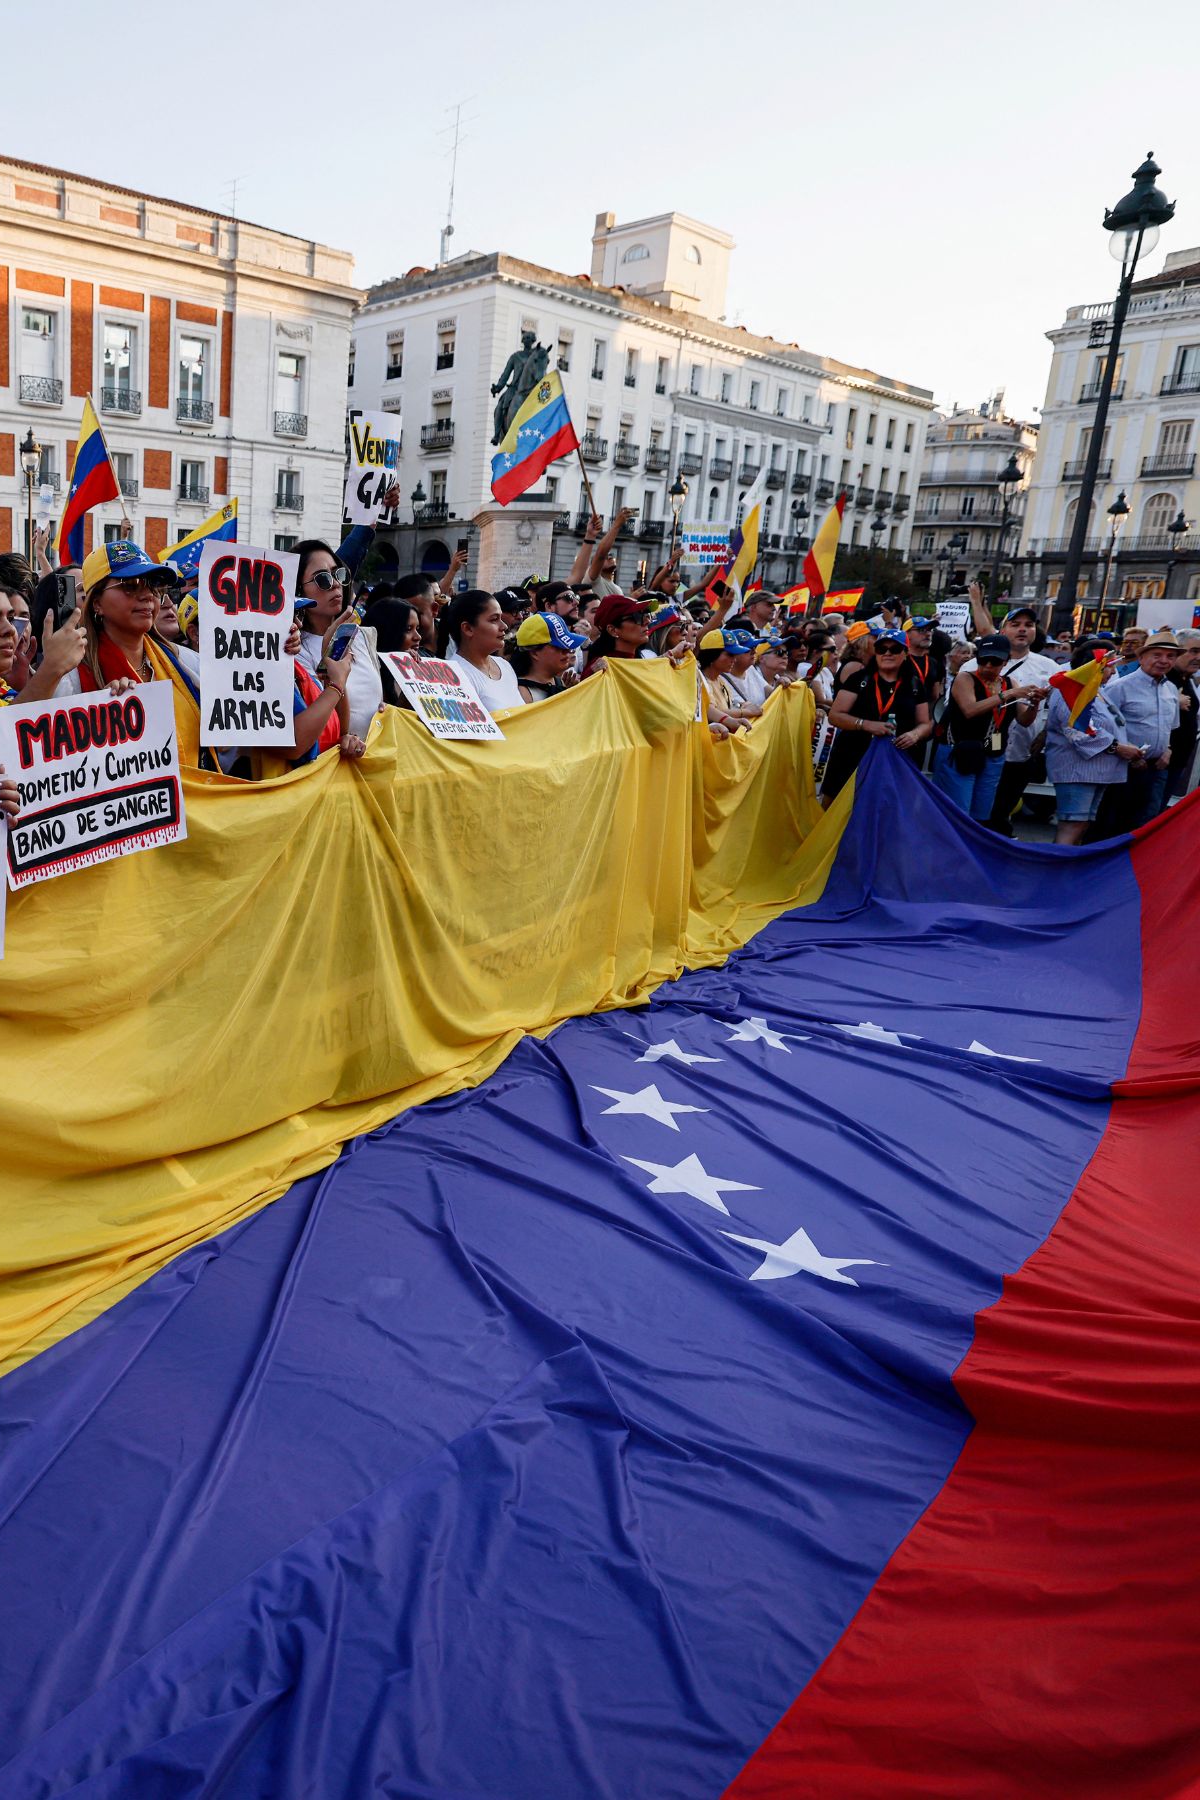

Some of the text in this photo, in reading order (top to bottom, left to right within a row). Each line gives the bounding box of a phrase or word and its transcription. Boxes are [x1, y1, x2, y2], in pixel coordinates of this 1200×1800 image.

[432, 390, 451, 399] HOSTAL
[701, 543, 727, 552] MUNDO
[208, 555, 286, 616] GNB
[214, 626, 280, 661] BAJEN
[232, 670, 265, 693] LAS
[405, 681, 438, 695] TIENE
[208, 698, 286, 732] ARMAS
[429, 722, 496, 734] TENEMOS VOTOS
[15, 695, 146, 770] MADURO
[17, 755, 88, 807] ROMETIÓ
[15, 790, 169, 859] BAÑO DE SANGRE
